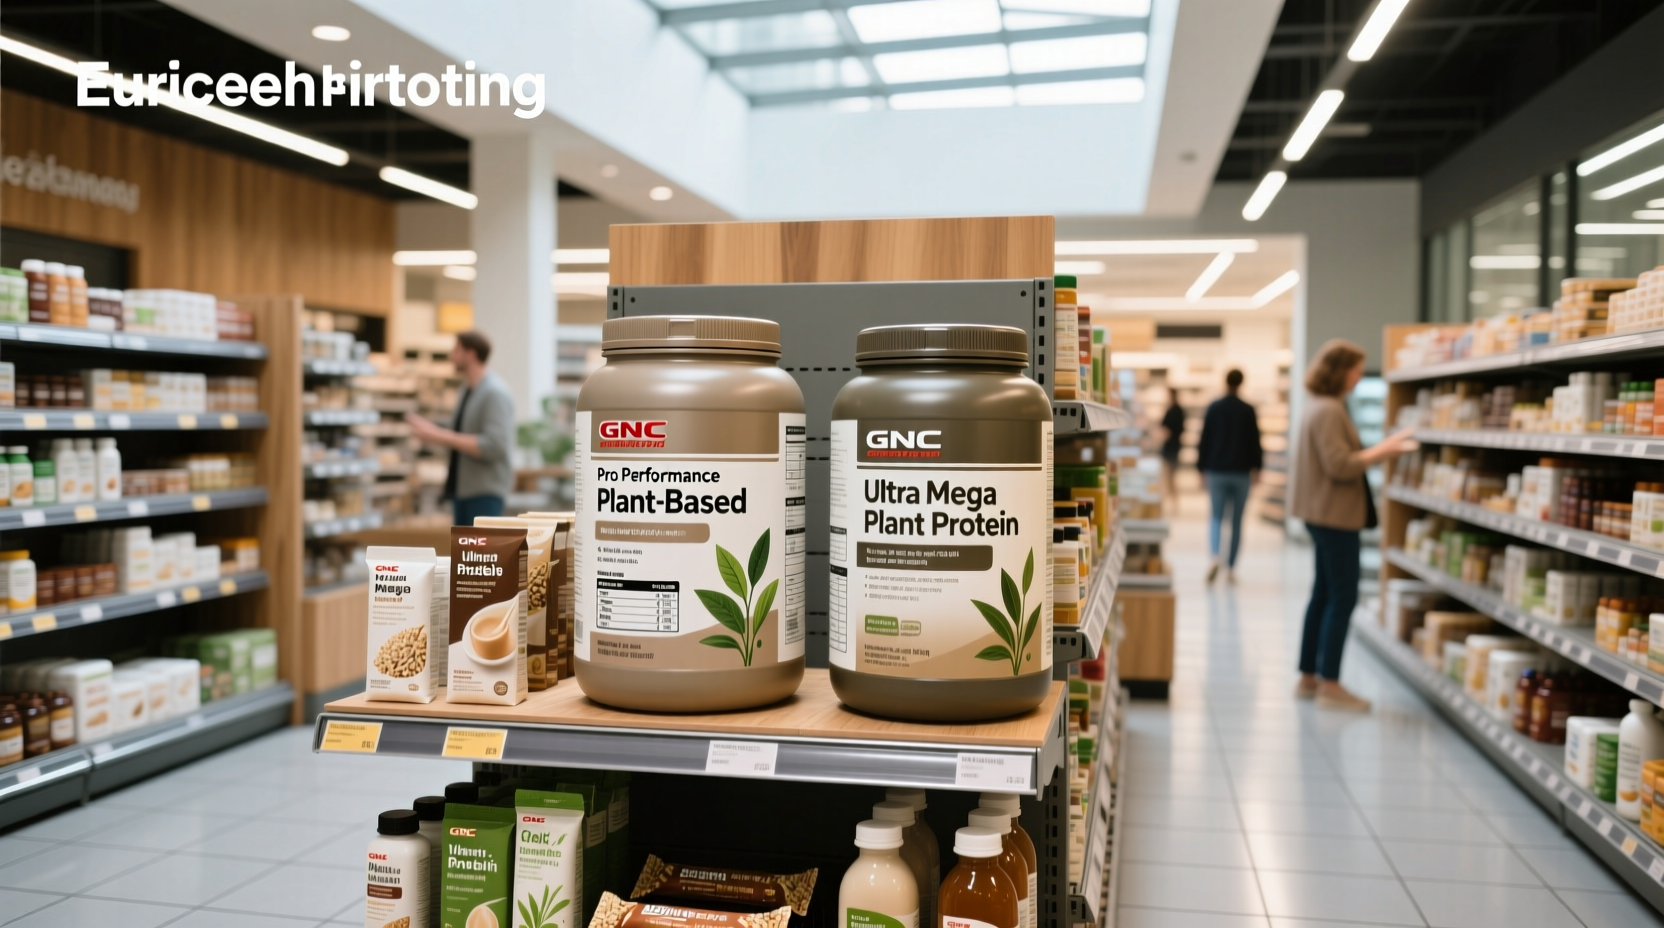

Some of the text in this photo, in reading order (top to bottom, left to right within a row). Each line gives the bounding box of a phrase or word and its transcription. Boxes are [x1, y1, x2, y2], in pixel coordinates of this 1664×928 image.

[599, 420, 667, 440] GNC
[866, 430, 942, 449] GNC
[597, 467, 721, 483] Pro Performance
[597, 487, 747, 514] Plant-Based
[864, 479, 997, 512] Ultra Mega
[864, 509, 1019, 536] Plant Protein
